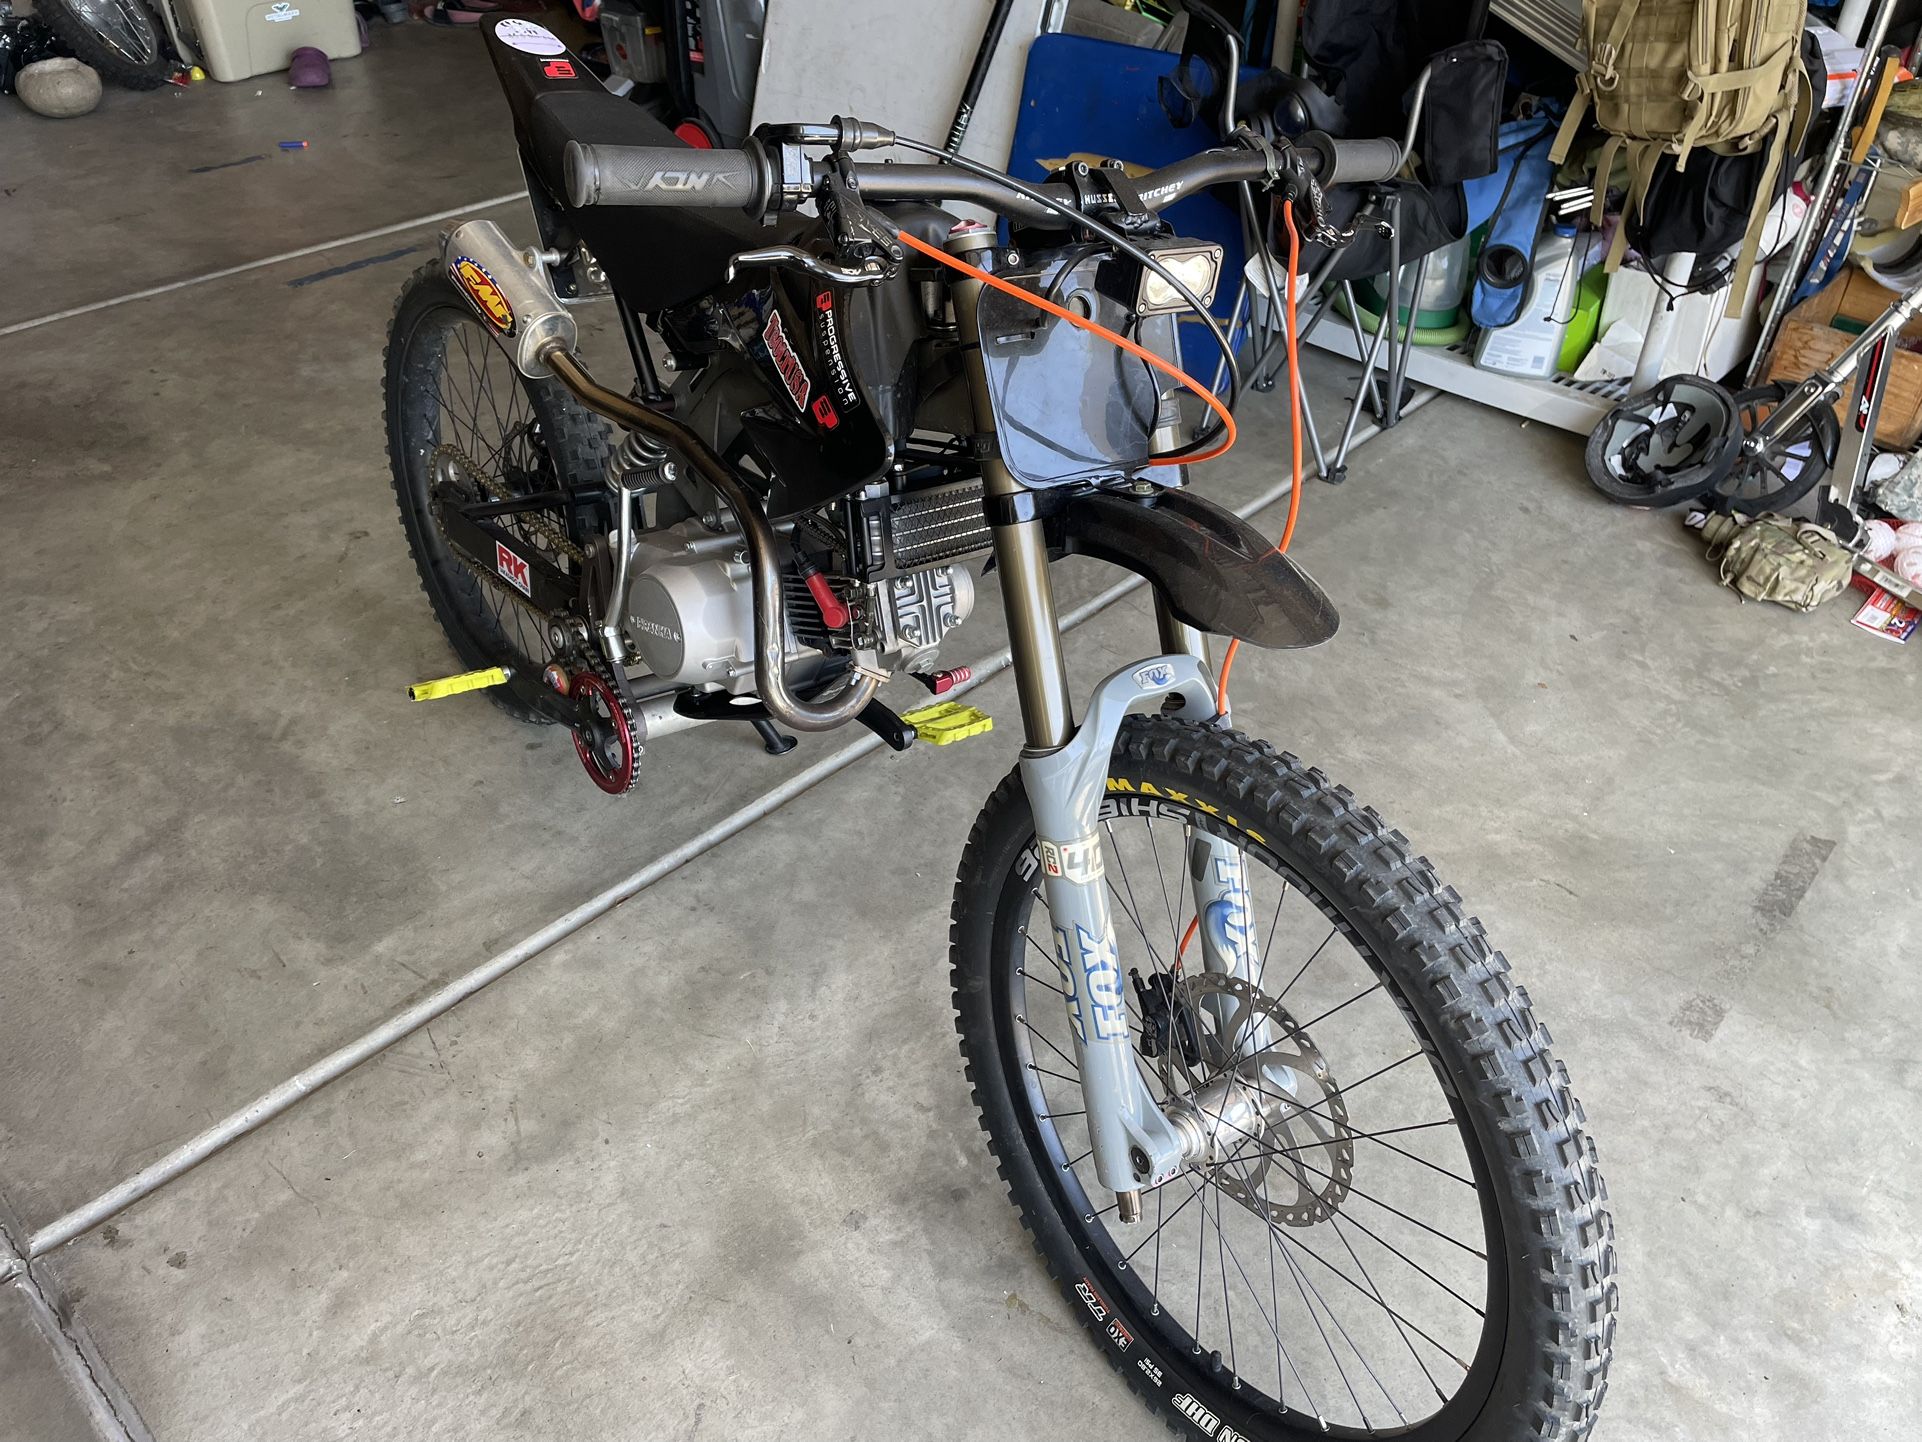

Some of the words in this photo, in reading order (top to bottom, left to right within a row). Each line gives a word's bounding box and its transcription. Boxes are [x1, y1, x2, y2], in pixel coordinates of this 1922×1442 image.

[1084, 193, 1117, 205] HUSSE
[818, 313, 849, 406] suspension
[825, 309, 857, 402] PROGRESSIVE
[497, 544, 529, 588] RK
[1139, 664, 1170, 688] FOX
[1044, 845, 1059, 874] RC2
[1075, 923, 1130, 1040] FOX
[1075, 1282, 1107, 1322] TR
[1108, 1324, 1128, 1349] EXO
[1143, 1357, 1155, 1369] PSI
[1172, 1394, 1221, 1437] DHF
